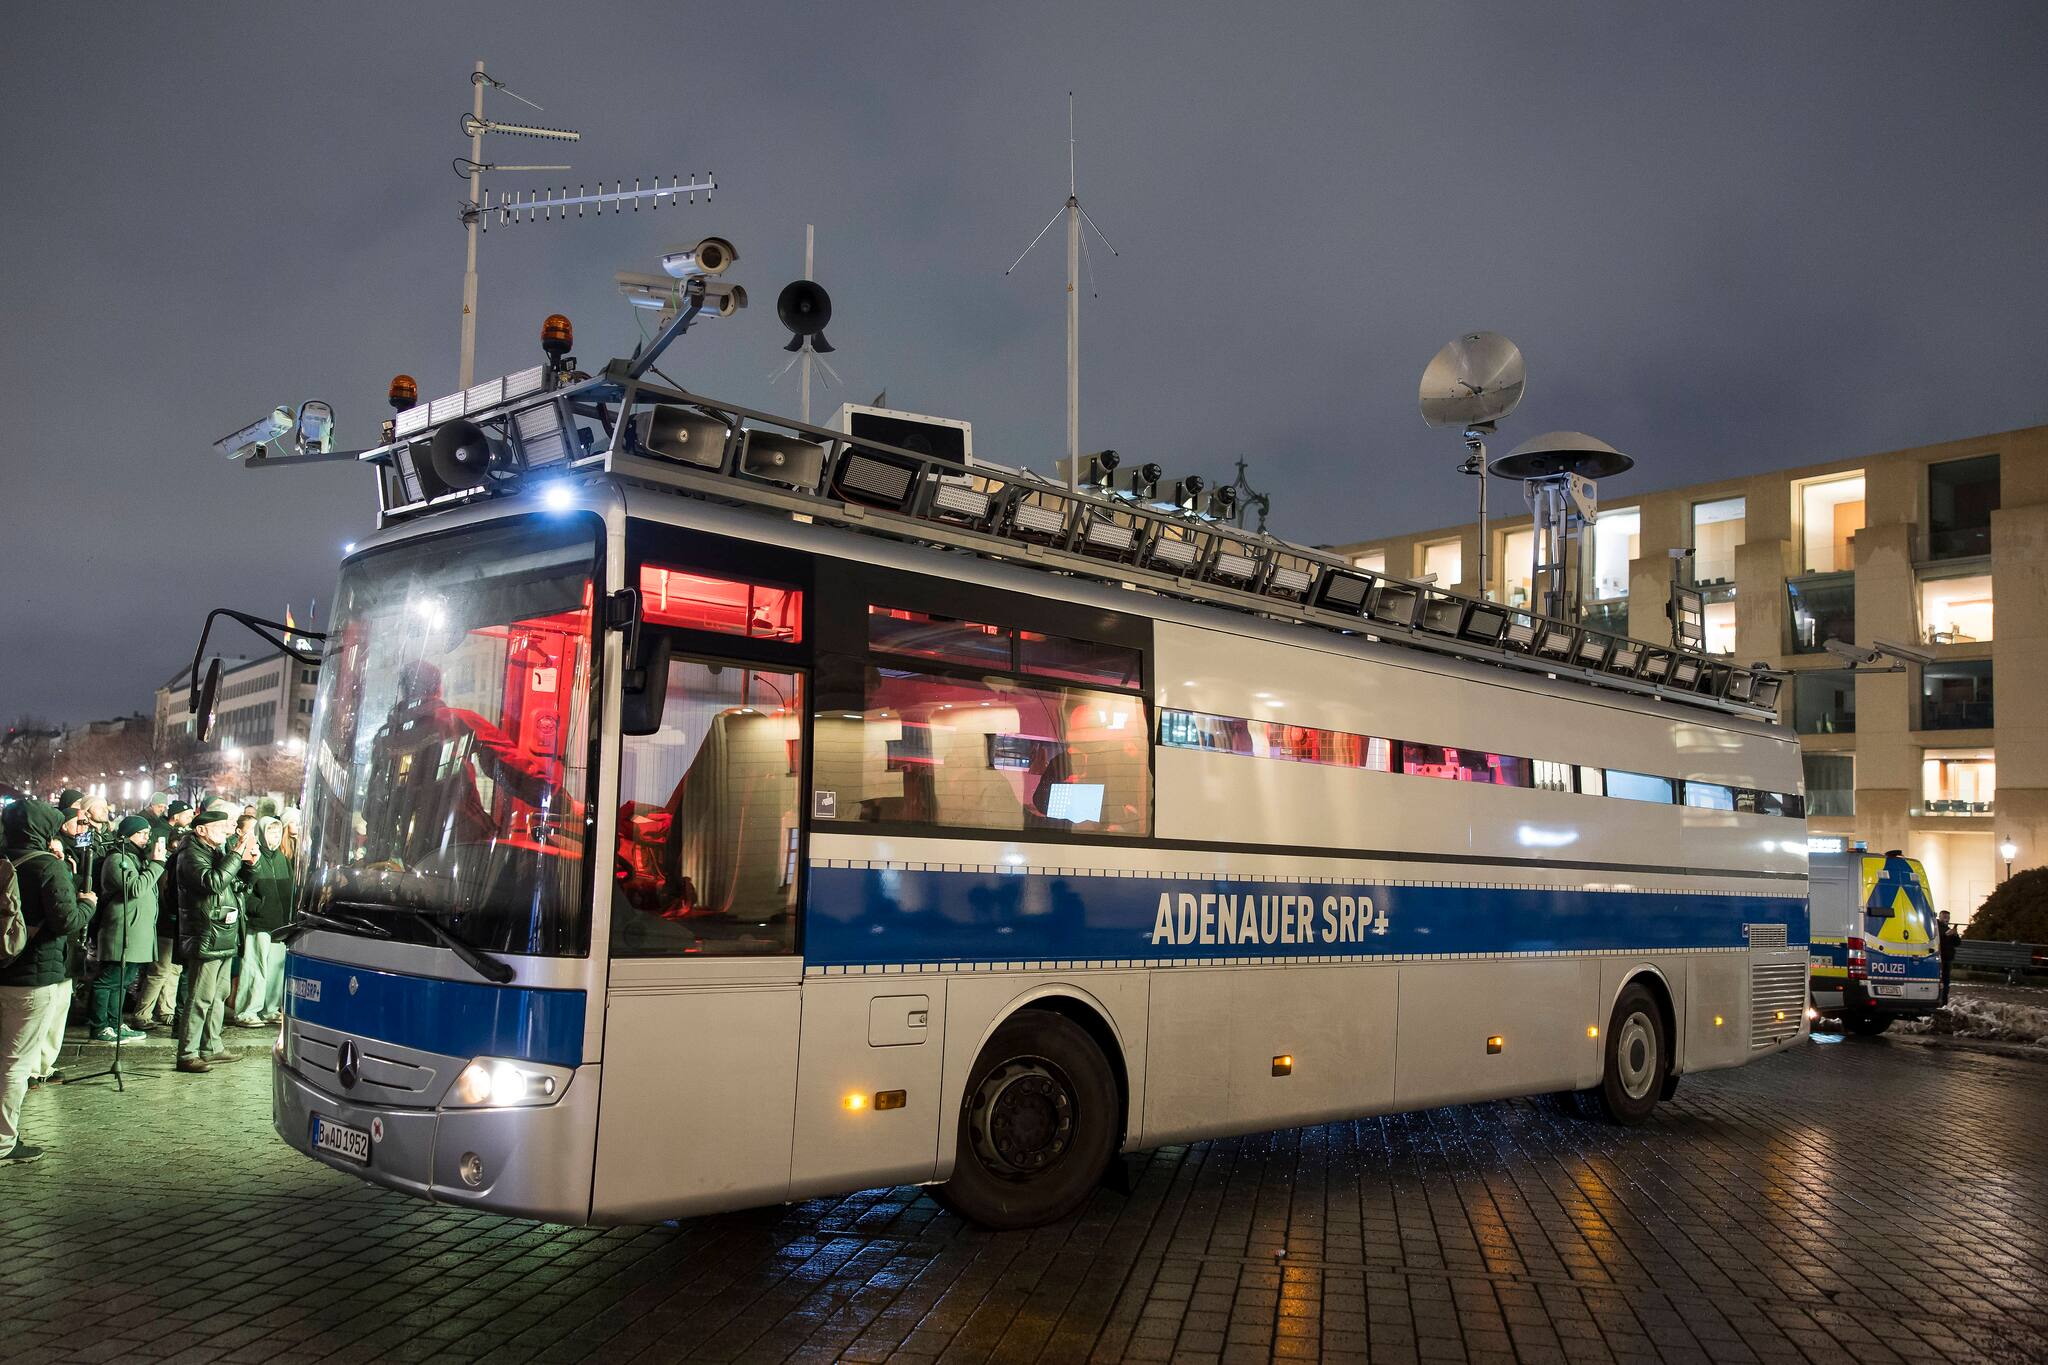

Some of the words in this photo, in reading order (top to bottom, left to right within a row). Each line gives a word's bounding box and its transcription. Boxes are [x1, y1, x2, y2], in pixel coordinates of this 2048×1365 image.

[1151, 892, 1315, 945] ADENAUER
[1321, 895, 1390, 944] SRP+
[1871, 962, 1906, 975] POLIZEI
[342, 1130, 368, 1157] 1952
